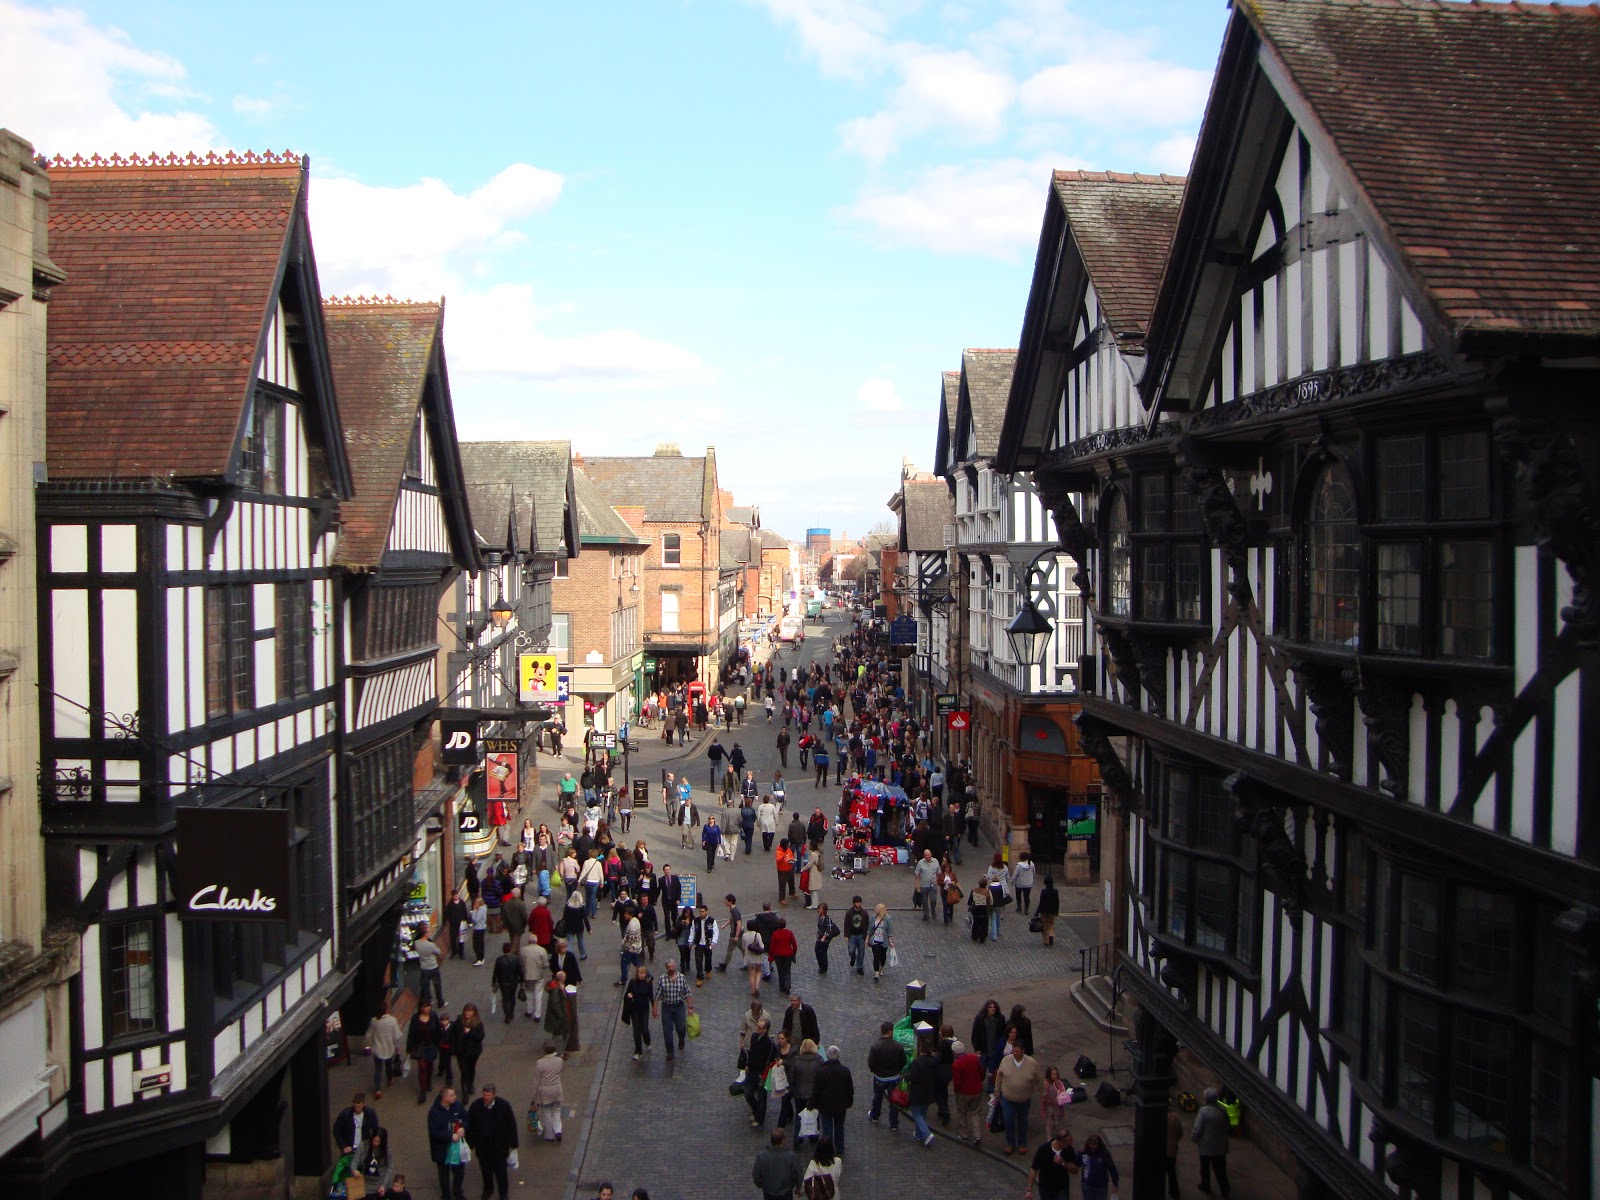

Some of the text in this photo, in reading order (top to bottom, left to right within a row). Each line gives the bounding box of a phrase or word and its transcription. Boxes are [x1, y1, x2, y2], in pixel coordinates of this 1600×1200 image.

[938, 696, 955, 704] LUSH
[445, 732, 471, 749] JD
[460, 816, 478, 829] JD
[189, 884, 276, 911] Clarks
